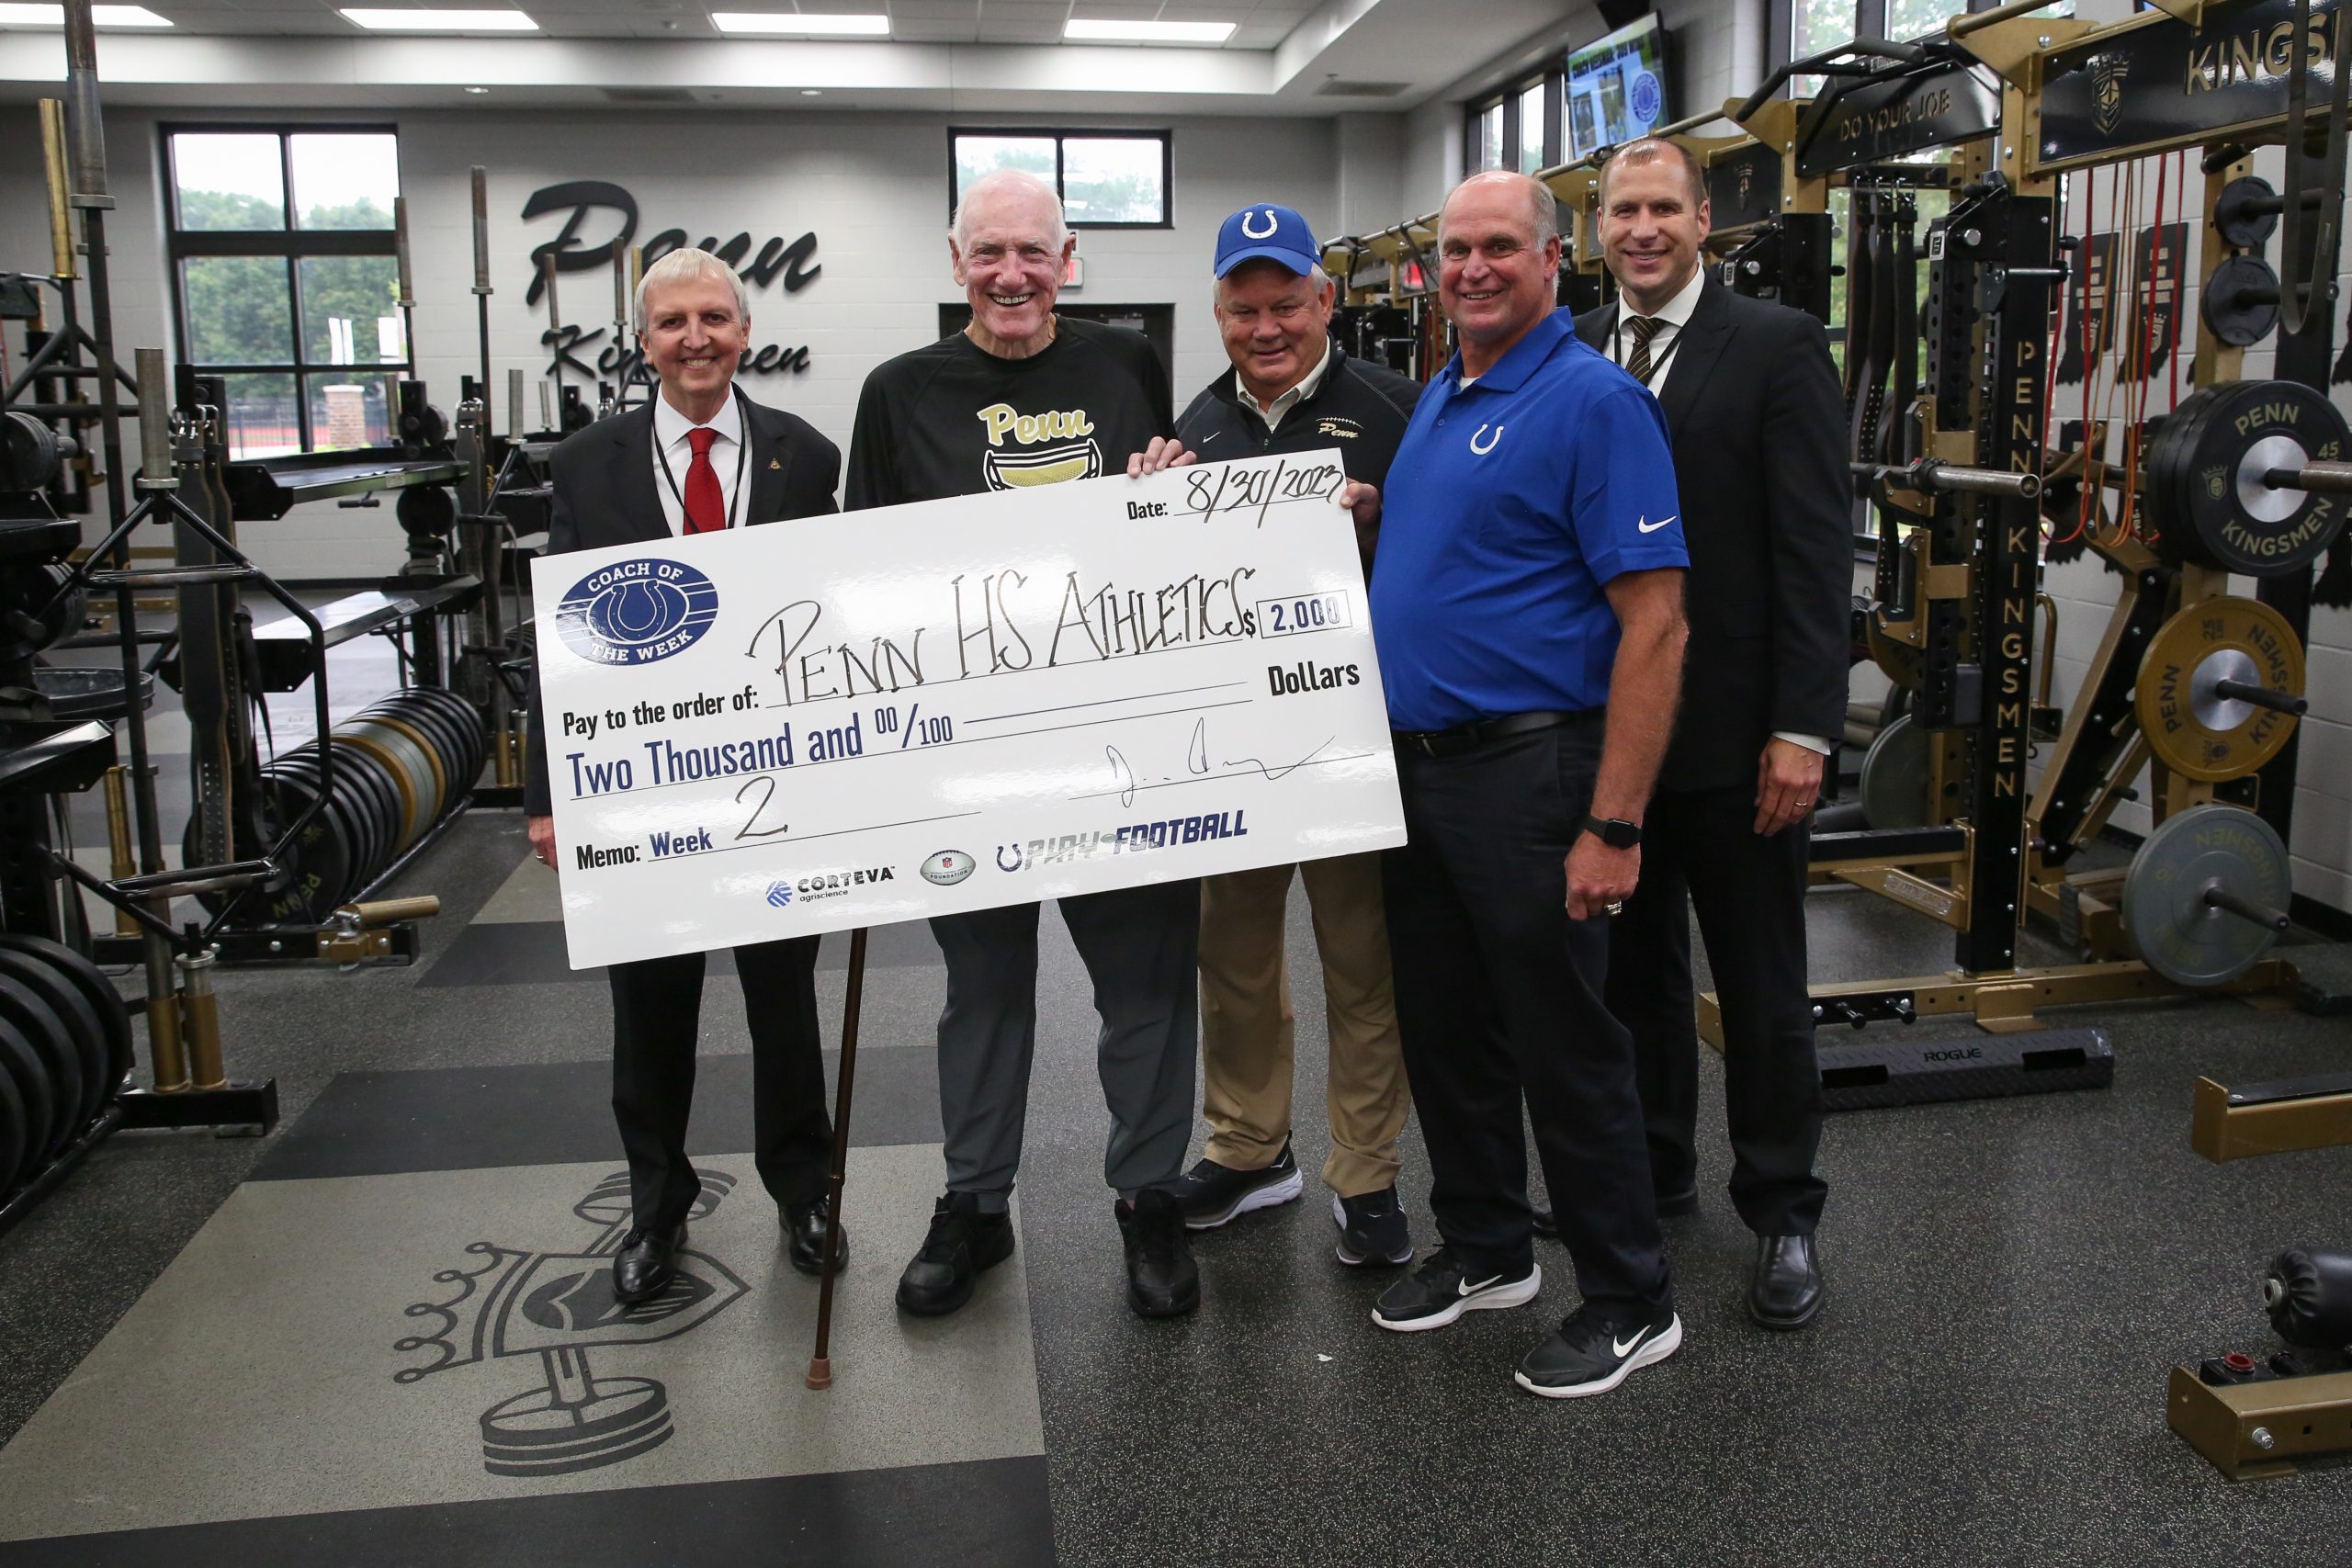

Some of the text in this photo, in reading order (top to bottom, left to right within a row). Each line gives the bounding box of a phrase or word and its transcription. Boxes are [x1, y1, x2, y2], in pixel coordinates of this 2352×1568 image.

[2185, 7, 2341, 96] KINGS
[1840, 116, 1862, 141] DO
[1867, 100, 1912, 133] YOUR
[976, 402, 1095, 446] Penn
[1317, 422, 1359, 439] Penn
[2233, 401, 2300, 436] PENN
[2317, 441, 2340, 459] 45
[1126, 500, 1170, 521] Date:
[1185, 458, 1345, 529] 8/30/2023
[2221, 496, 2335, 556] KINGSMEN
[587, 562, 684, 593] COACH OF
[1994, 340, 2036, 798] PENN KINGSMEN
[1271, 595, 1341, 634] 2,000
[591, 629, 694, 662] THE WEEK
[744, 566, 1256, 708] PENN HS ATHLETICS
[1268, 660, 1361, 697] Dollars
[2160, 664, 2183, 734] PENN
[2247, 623, 2289, 745] KISMEN
[562, 685, 760, 740] Pay to the order of:
[565, 752, 633, 797] Two
[645, 722, 795, 785] Thousand
[808, 712, 864, 762] and
[734, 775, 789, 841] 2
[575, 827, 713, 871] Memo: Week
[1113, 809, 1249, 855] FOOTBALL
[799, 888, 849, 903] agriscience
[930, 869, 968, 879] FOUNDATION
[1924, 1047, 1982, 1063] ROGUE
